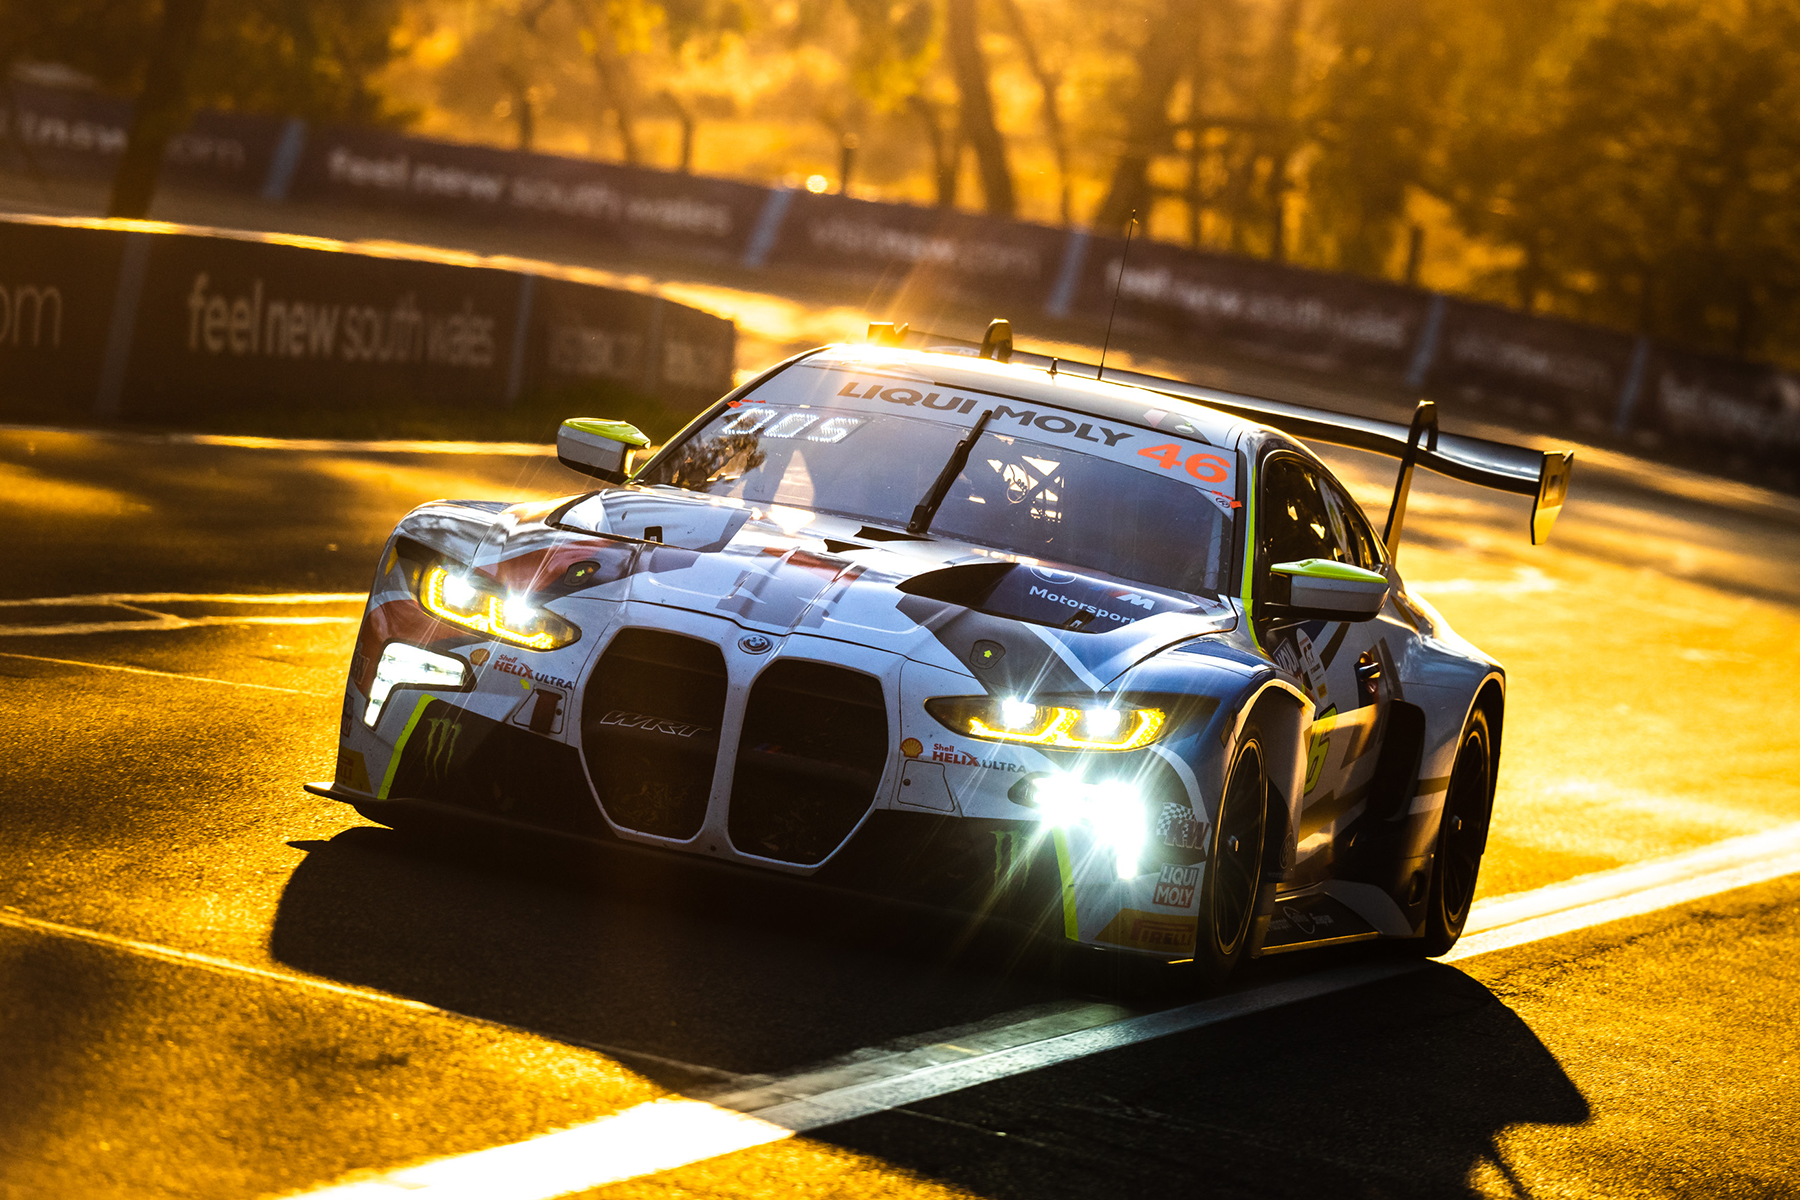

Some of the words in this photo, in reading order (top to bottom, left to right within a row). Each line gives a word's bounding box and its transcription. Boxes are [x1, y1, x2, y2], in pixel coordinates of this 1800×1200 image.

[188, 273, 263, 356] feel
[265, 302, 340, 358] new
[342, 291, 423, 362] south
[837, 381, 978, 414] LIQUI
[991, 405, 1135, 447] MOLY
[1137, 443, 1232, 484] 46
[1029, 585, 1138, 626] Motorsport
[498, 653, 518, 664] Shell
[493, 660, 534, 680] HELIX
[534, 672, 573, 691] ULTRA
[600, 710, 713, 738] WRT
[932, 750, 980, 768] HELIX
[981, 759, 1028, 774] ULTRA
[933, 743, 955, 753] Shell
[1163, 817, 1212, 850] KW
[1159, 865, 1199, 887] LIQUI
[1154, 884, 1195, 907] MOLY
[1130, 918, 1196, 947] PIRELLI
